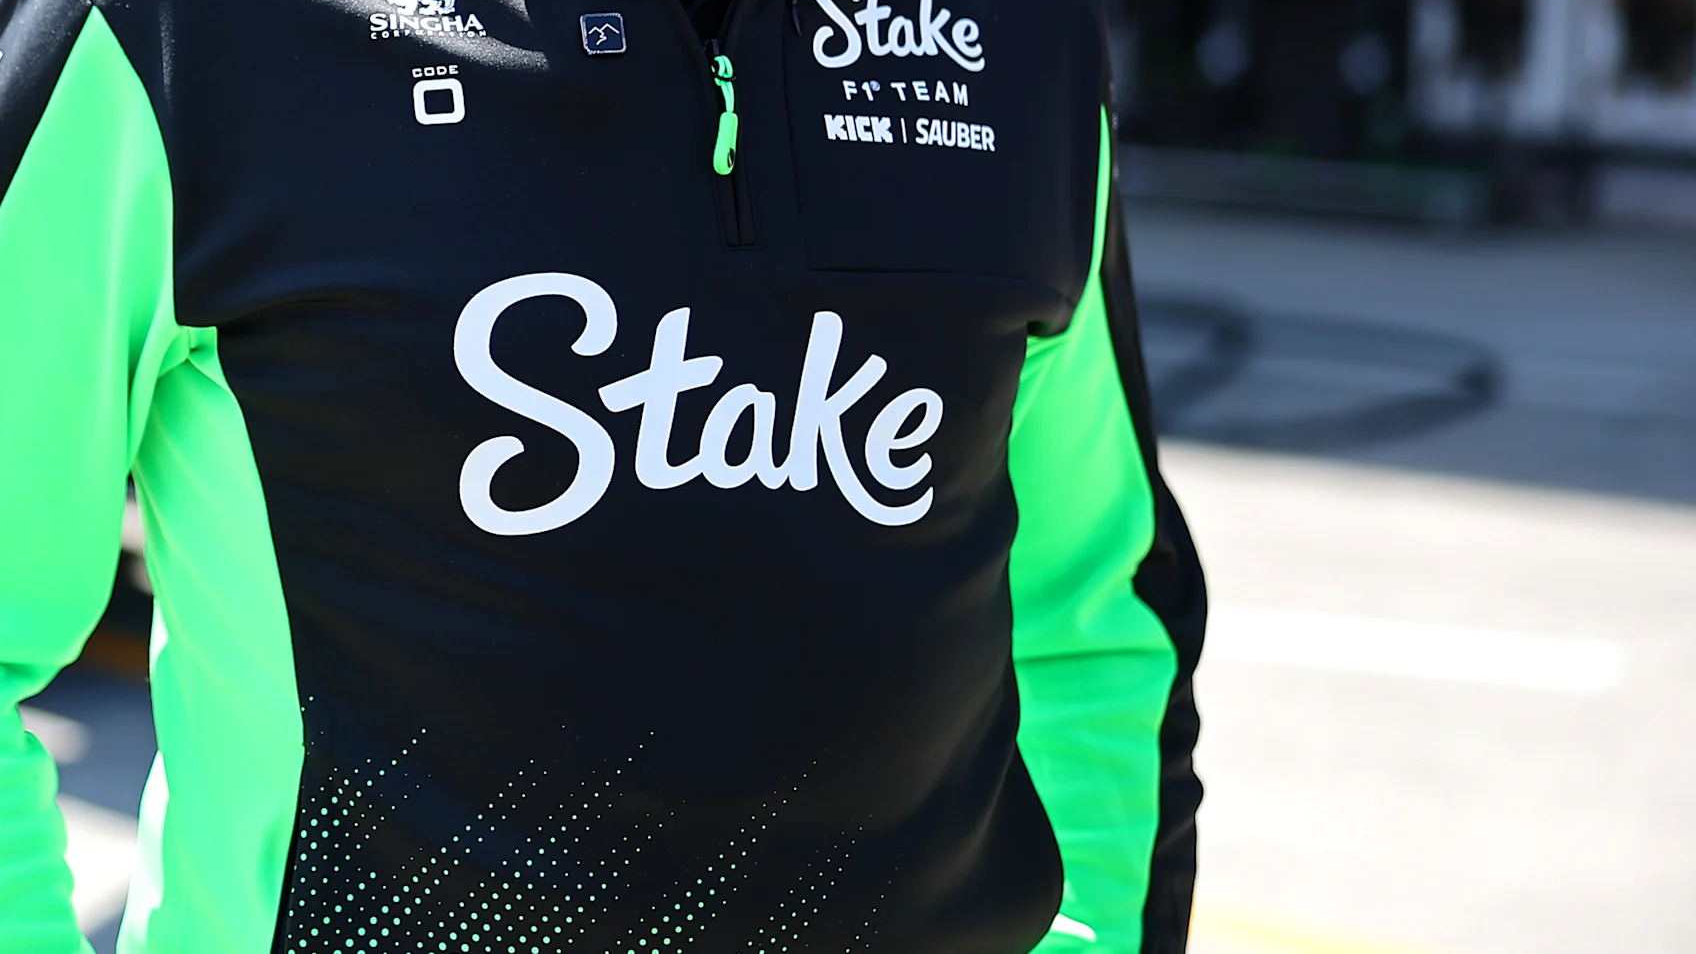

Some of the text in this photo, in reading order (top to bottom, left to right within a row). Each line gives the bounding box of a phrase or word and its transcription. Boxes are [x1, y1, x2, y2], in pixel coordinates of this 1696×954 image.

[369, 13, 485, 32] SINGHA
[411, 64, 459, 78] CODE
[890, 80, 969, 107] TEAM
[824, 114, 996, 152] KICK SAUBER
[453, 272, 944, 536] Stake
